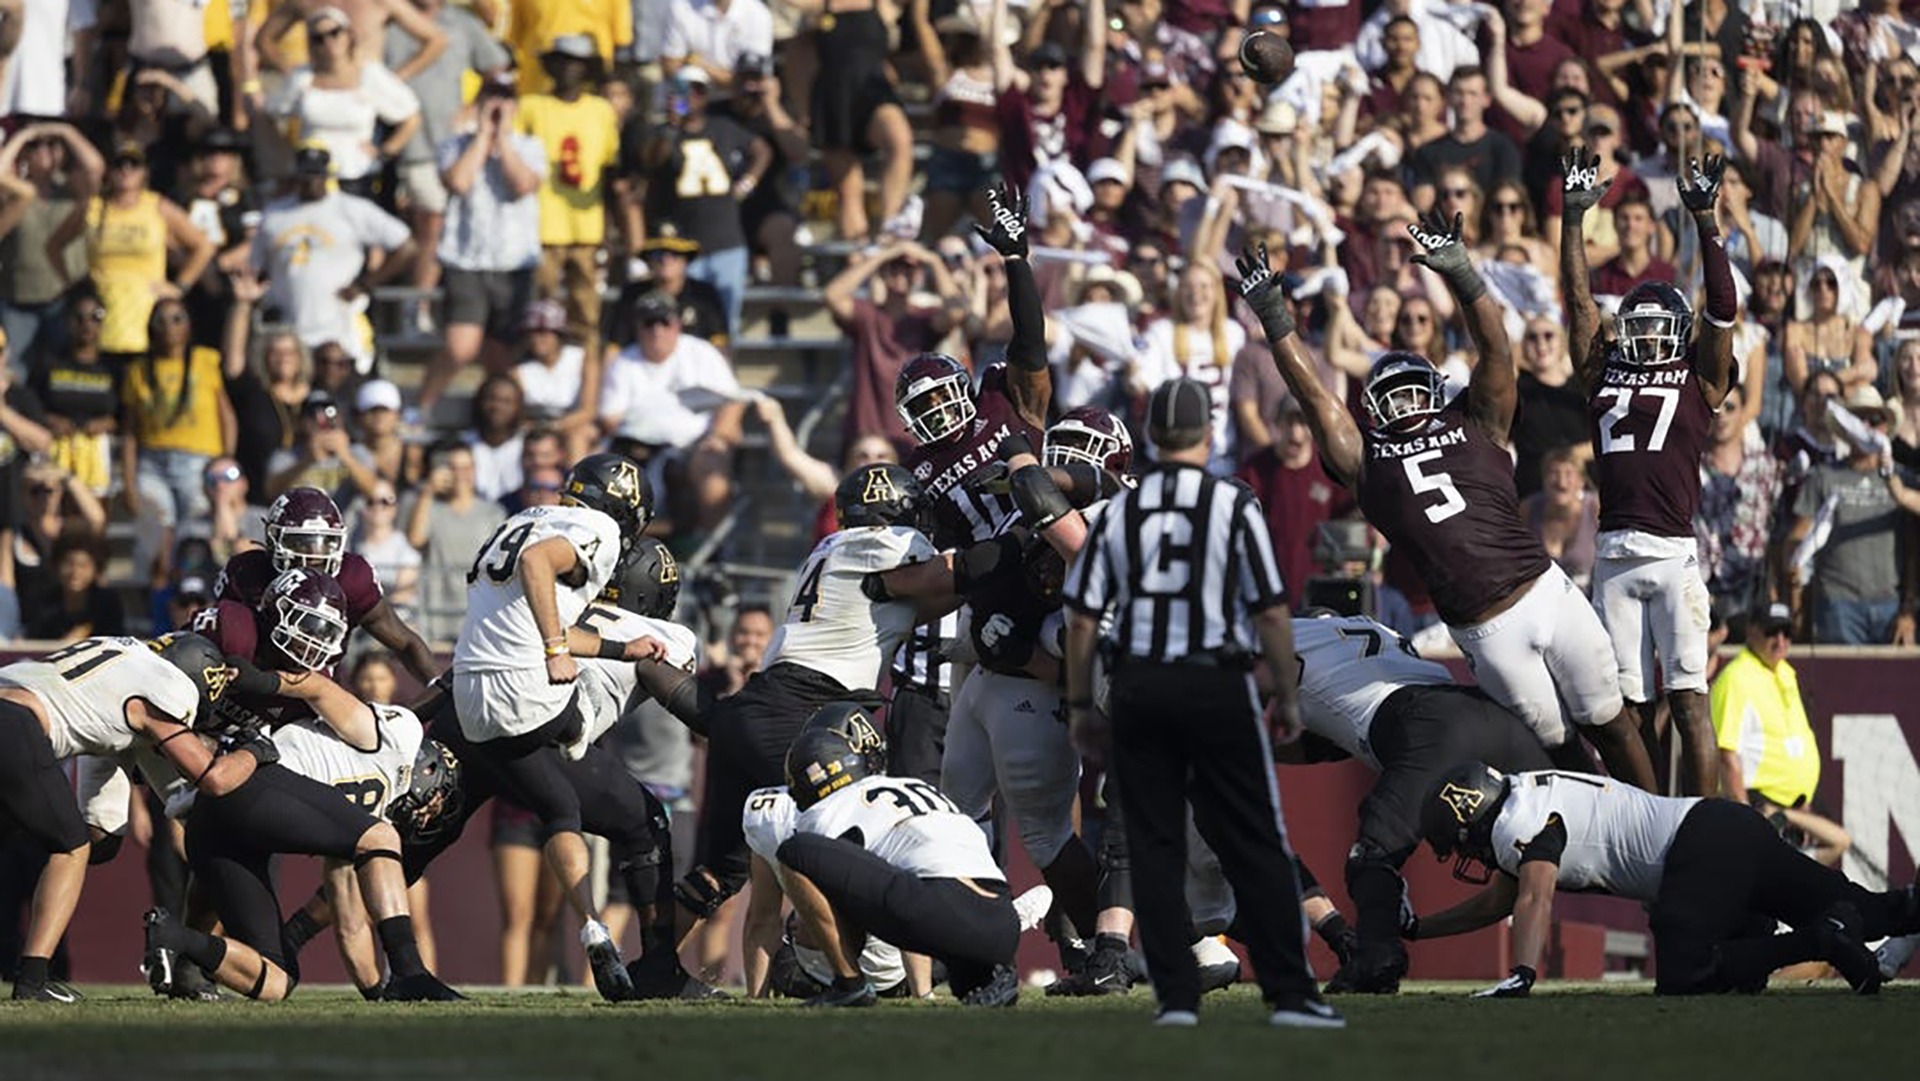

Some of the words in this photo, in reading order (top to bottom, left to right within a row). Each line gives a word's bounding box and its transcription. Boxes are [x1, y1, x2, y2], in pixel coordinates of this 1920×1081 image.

[676, 138, 731, 197] A
[1597, 386, 1680, 455] 27
[862, 466, 900, 503] A
[924, 455, 978, 500] TEXAS
[978, 423, 1012, 463] A&M
[1401, 448, 1467, 524] 5
[1139, 511, 1194, 594] C
[788, 558, 827, 623] 4
[849, 712, 882, 754] A
[1439, 782, 1486, 824] A
